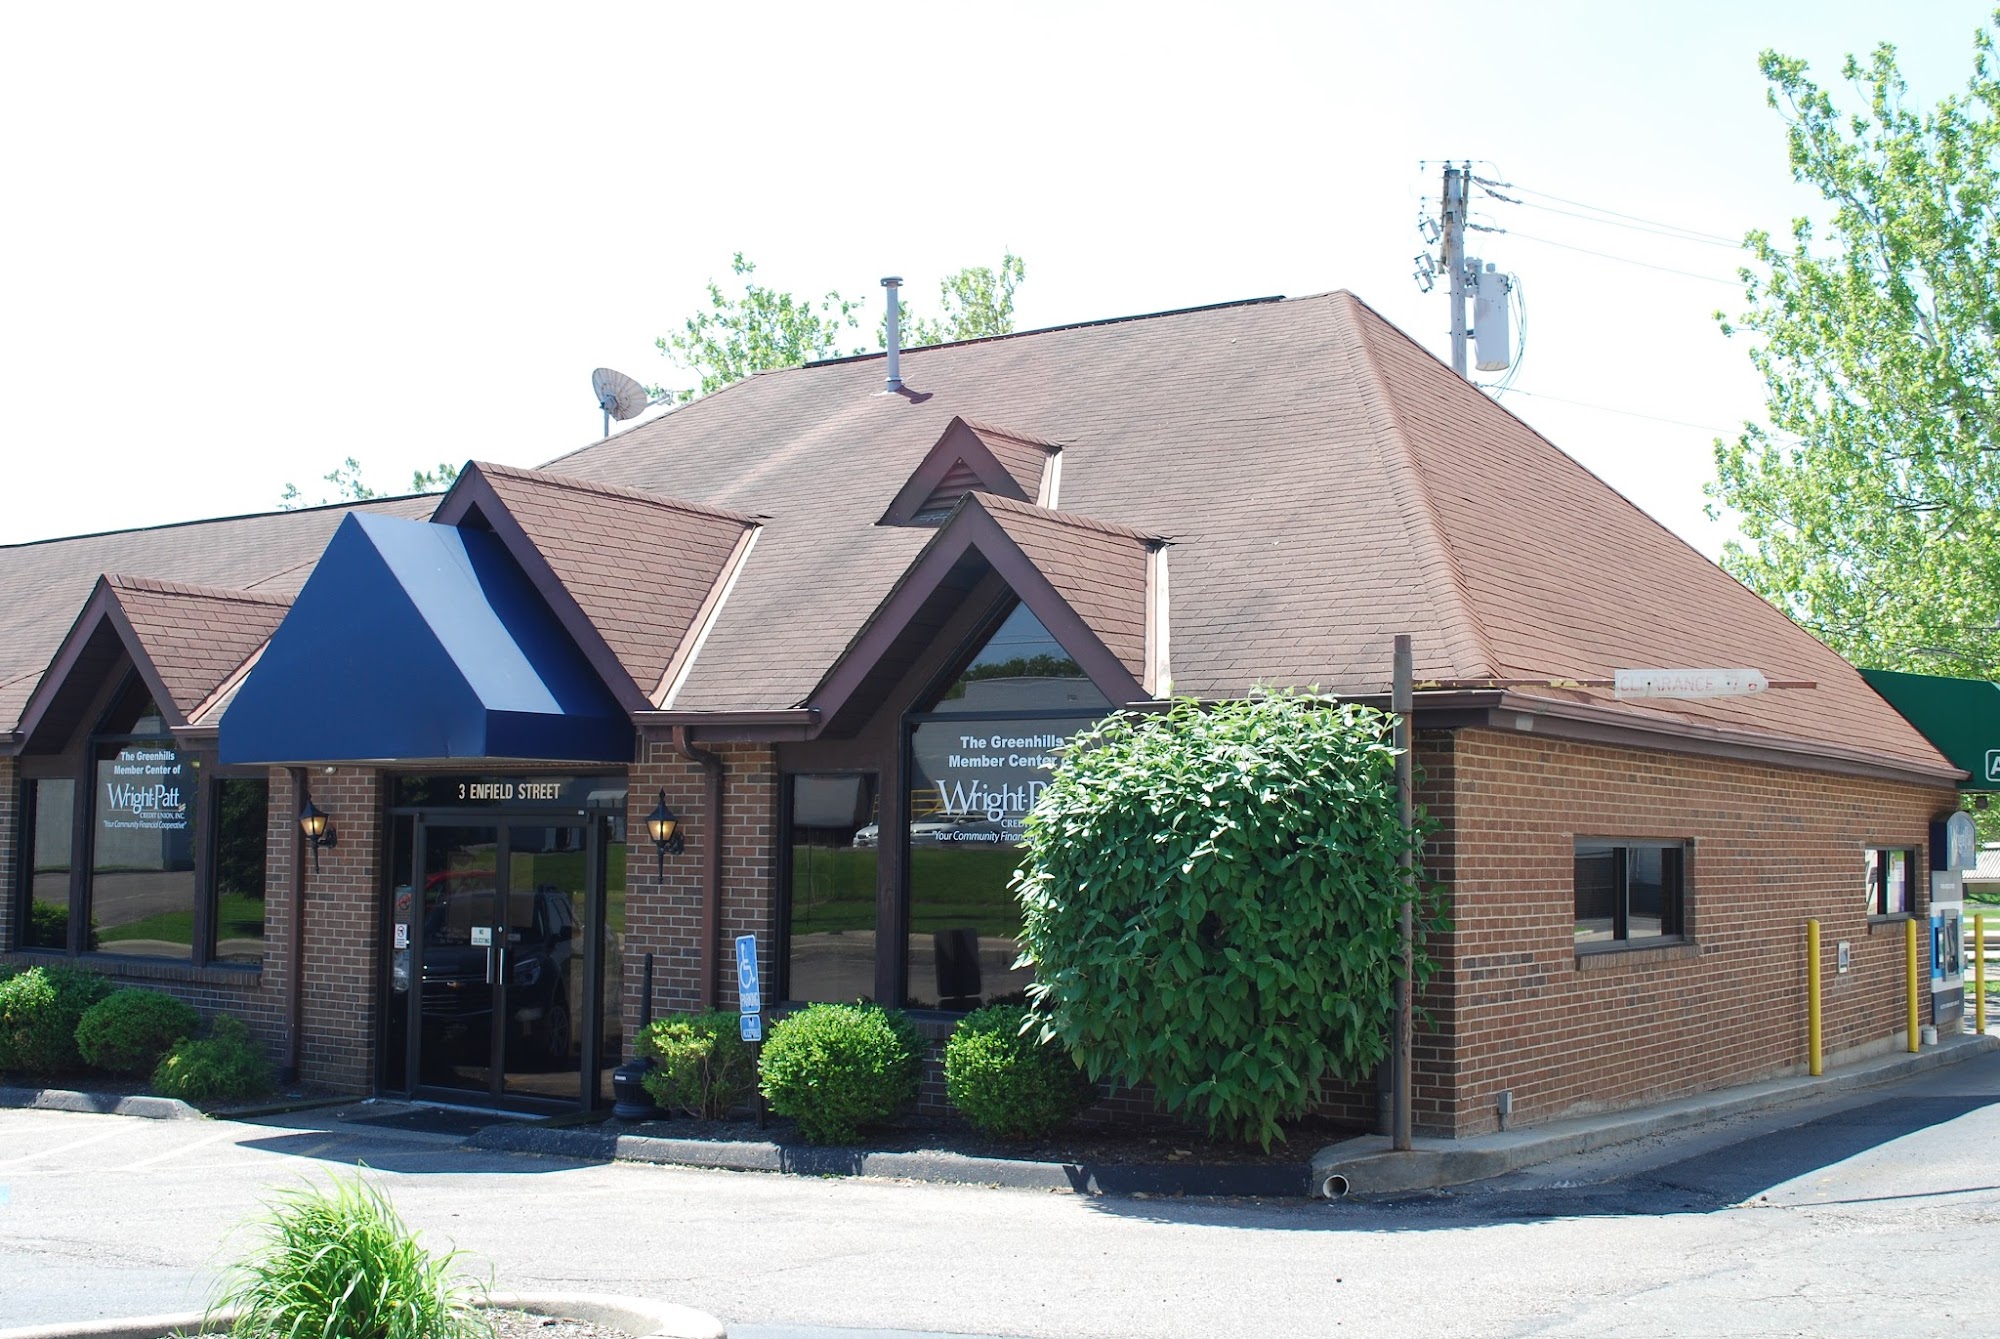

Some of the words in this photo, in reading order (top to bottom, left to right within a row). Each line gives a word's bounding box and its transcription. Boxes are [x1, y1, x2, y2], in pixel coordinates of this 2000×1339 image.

[960, 736, 987, 748] The
[991, 735, 1064, 748] Greenhills
[120, 752, 135, 761] The
[136, 751, 175, 761] Greenhills
[949, 755, 1005, 767] Member
[1009, 754, 1058, 767] Center
[114, 765, 144, 775] Member
[145, 765, 171, 775] Center
[172, 764, 181, 774] of
[459, 783, 466, 799] 3
[470, 783, 514, 799] ENFIELD
[518, 783, 561, 799] STREET
[935, 780, 1047, 822] Wright-P
[953, 831, 1000, 844] Community
